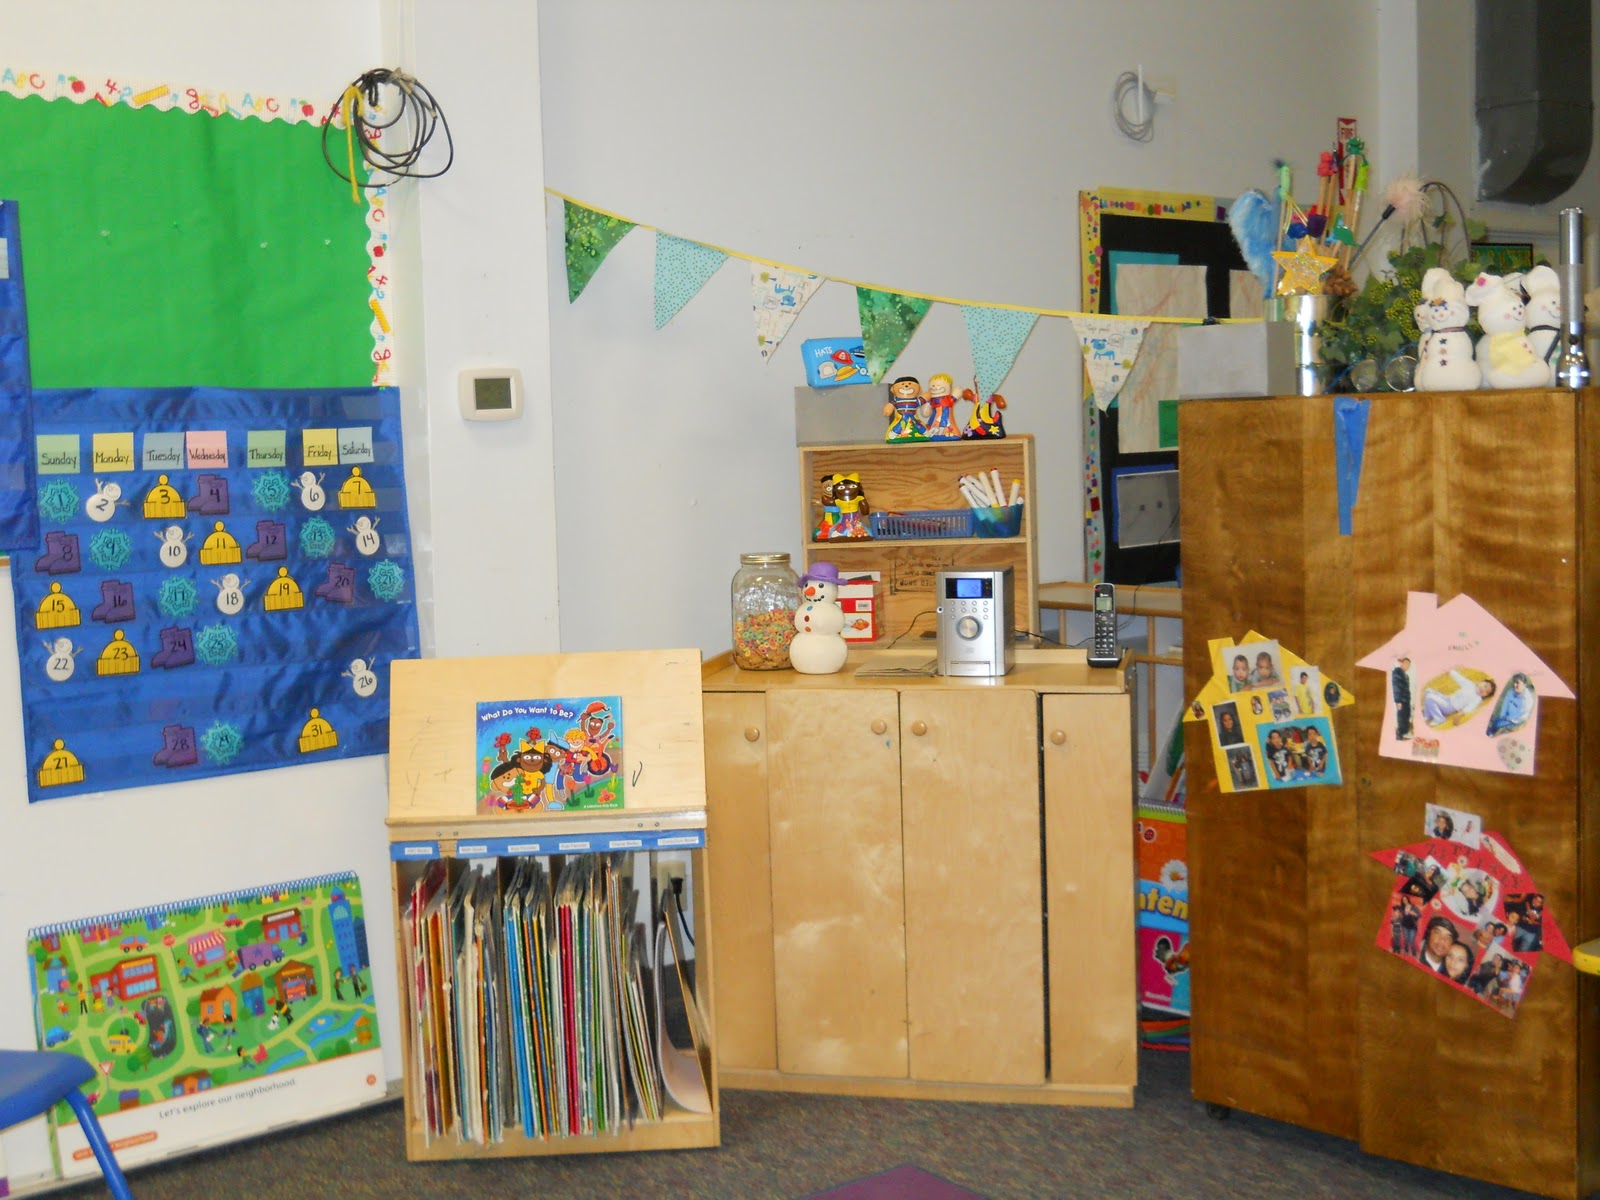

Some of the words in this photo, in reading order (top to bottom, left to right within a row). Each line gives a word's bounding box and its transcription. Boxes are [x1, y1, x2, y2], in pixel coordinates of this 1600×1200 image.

[814, 346, 833, 358] HATS
[41, 451, 77, 469] Sunday
[95, 447, 130, 464] Monday
[146, 447, 181, 465] Tuesday
[188, 447, 226, 463] Wednesday
[249, 448, 284, 461] Thursday
[307, 444, 332, 460] Friday
[342, 441, 371, 456] Saturday
[95, 498, 109, 512] 2
[159, 489, 171, 505] 3
[209, 488, 220, 503] 4
[267, 484, 277, 498] 5
[309, 487, 320, 502] 6
[352, 480, 361, 495] 7
[62, 544, 73, 562] 8
[168, 545, 181, 557] 10
[216, 538, 226, 549] 11
[265, 534, 277, 545] 12
[313, 531, 324, 542] 13
[362, 533, 375, 547] 14
[51, 599, 65, 613] 15
[113, 595, 127, 608] 16
[225, 592, 239, 606] 18
[279, 582, 290, 597] 19
[334, 576, 350, 588] 20
[382, 575, 393, 585] 21
[53, 657, 69, 671] 22
[112, 647, 129, 661] 23
[170, 639, 187, 652] 24
[210, 639, 224, 650] 25
[358, 675, 374, 689] 26
[481, 711, 500, 721] What
[502, 709, 513, 717] Do
[559, 709, 574, 719] Be?
[53, 756, 69, 770] 27
[171, 738, 190, 751] 28
[311, 724, 323, 738] 31
[158, 1106, 181, 1119] Let's
[182, 1099, 216, 1114] explore
[218, 1094, 233, 1104] our
[235, 1077, 296, 1099] neighborhood
